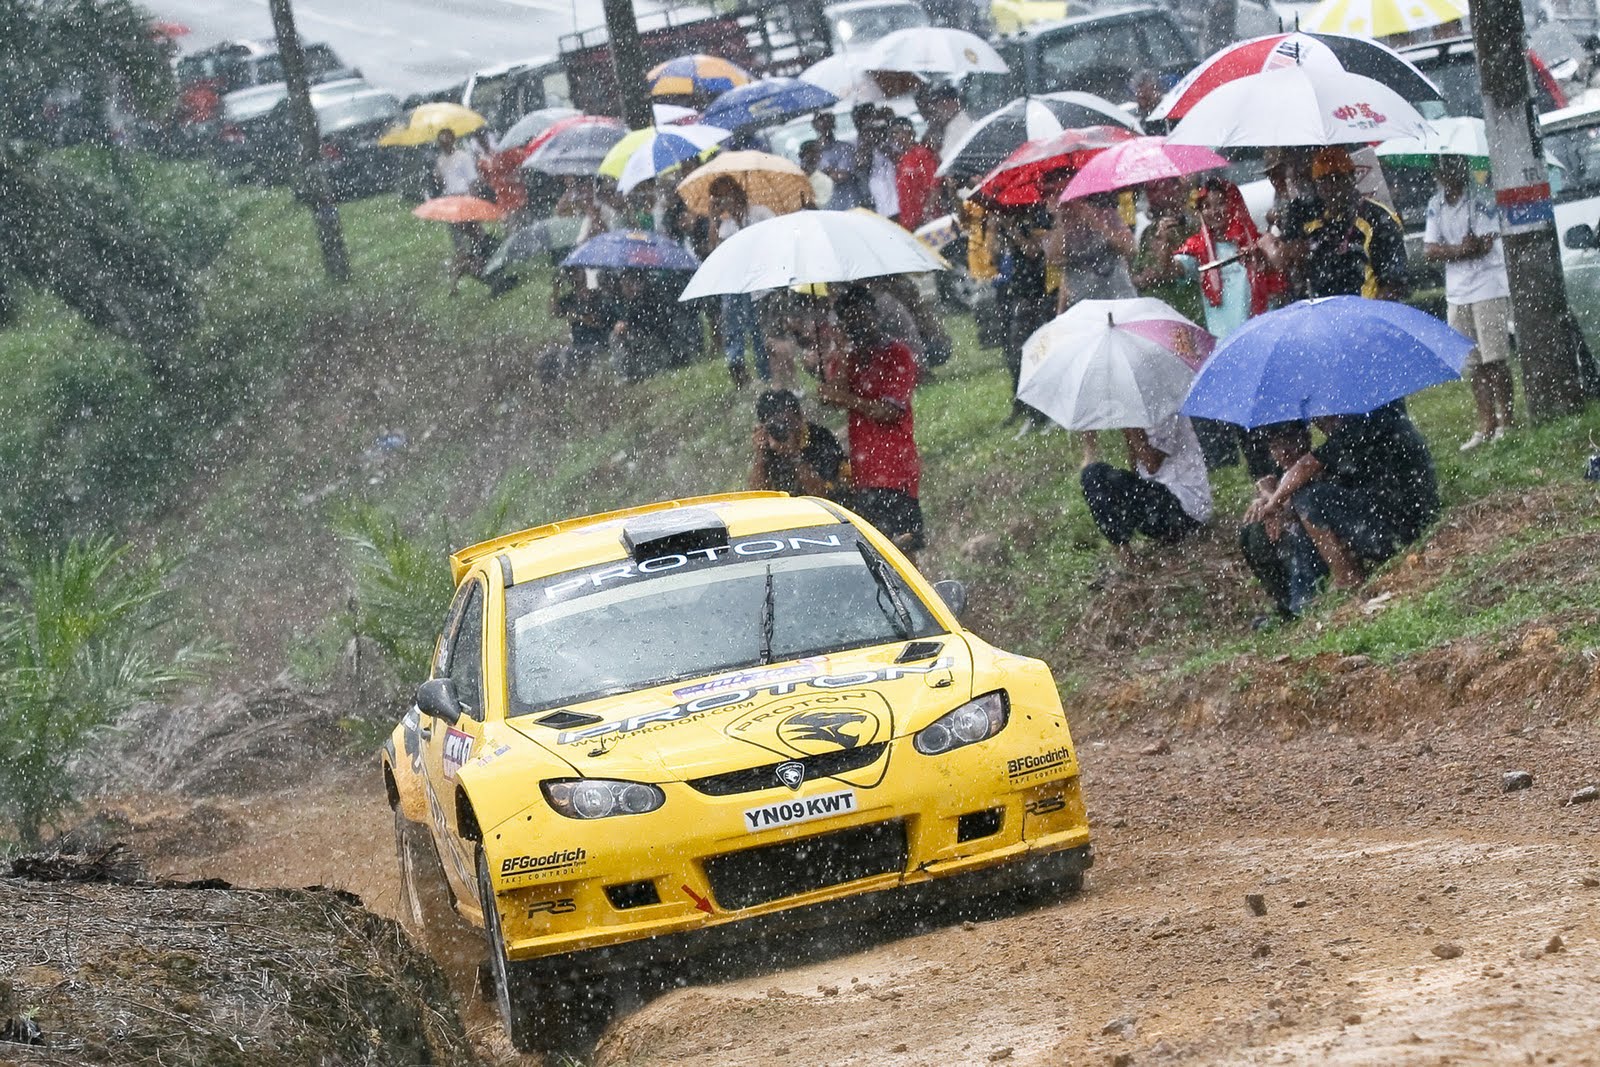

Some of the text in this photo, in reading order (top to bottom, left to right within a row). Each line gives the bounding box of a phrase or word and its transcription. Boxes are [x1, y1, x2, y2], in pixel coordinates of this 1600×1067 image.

[544, 534, 841, 598] PROTON
[554, 657, 954, 744] PROTON
[734, 693, 866, 731] PROTON
[1007, 746, 1069, 774] BFGoodrich
[745, 793, 853, 827] YN09 KWT
[501, 847, 586, 872] BFGoodrich
[529, 868, 574, 880] CONTROL
